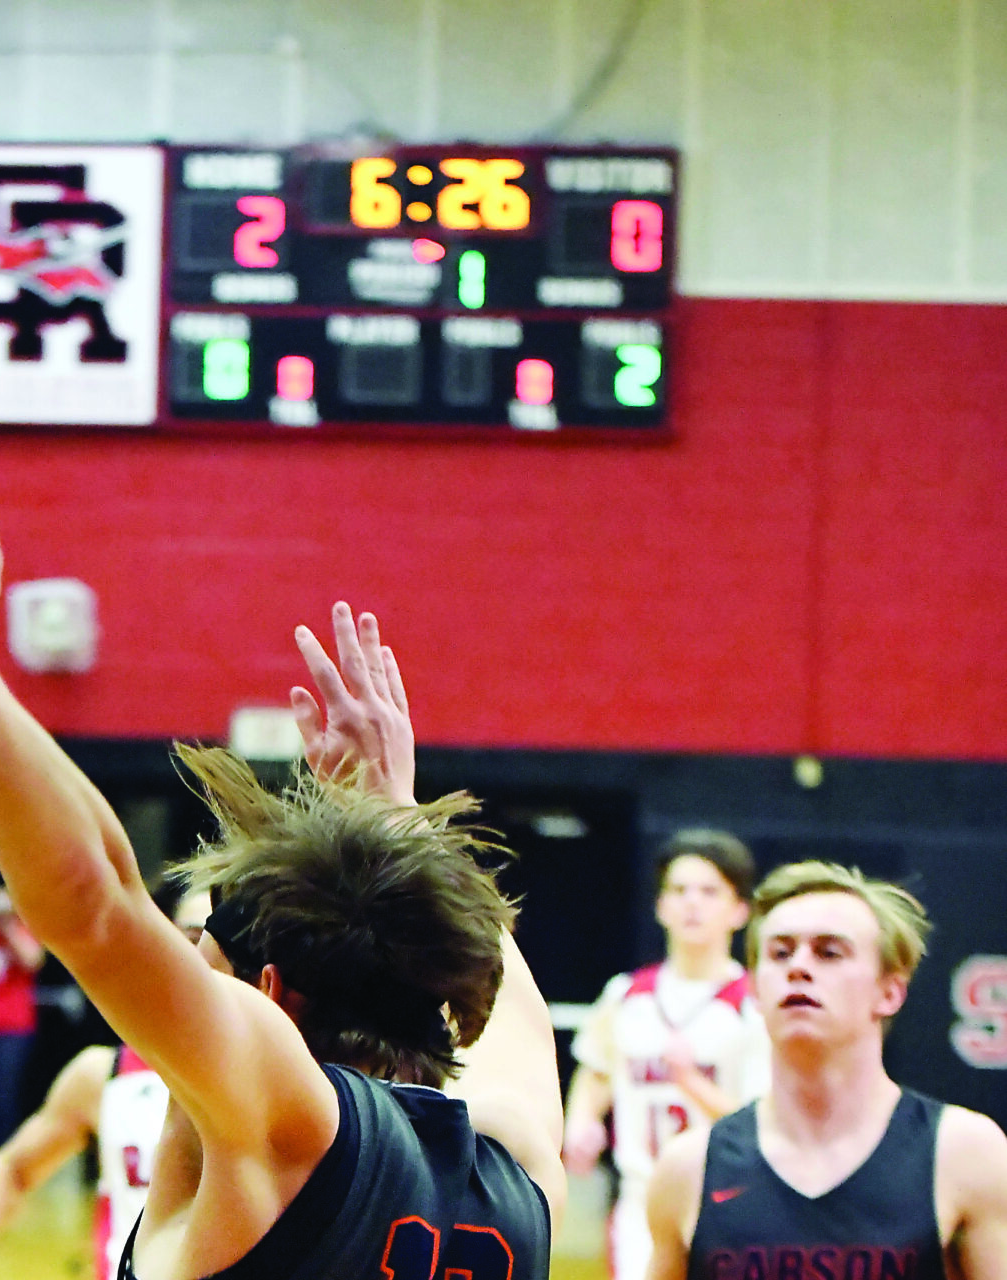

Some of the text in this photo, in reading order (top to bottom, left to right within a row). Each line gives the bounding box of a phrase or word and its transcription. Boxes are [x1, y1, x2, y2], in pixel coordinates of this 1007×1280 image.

[350, 157, 530, 230] 6:26
[234, 195, 286, 268] 2
[611, 200, 663, 273] 0
[458, 250, 486, 310] 1
[614, 343, 662, 407] 2
